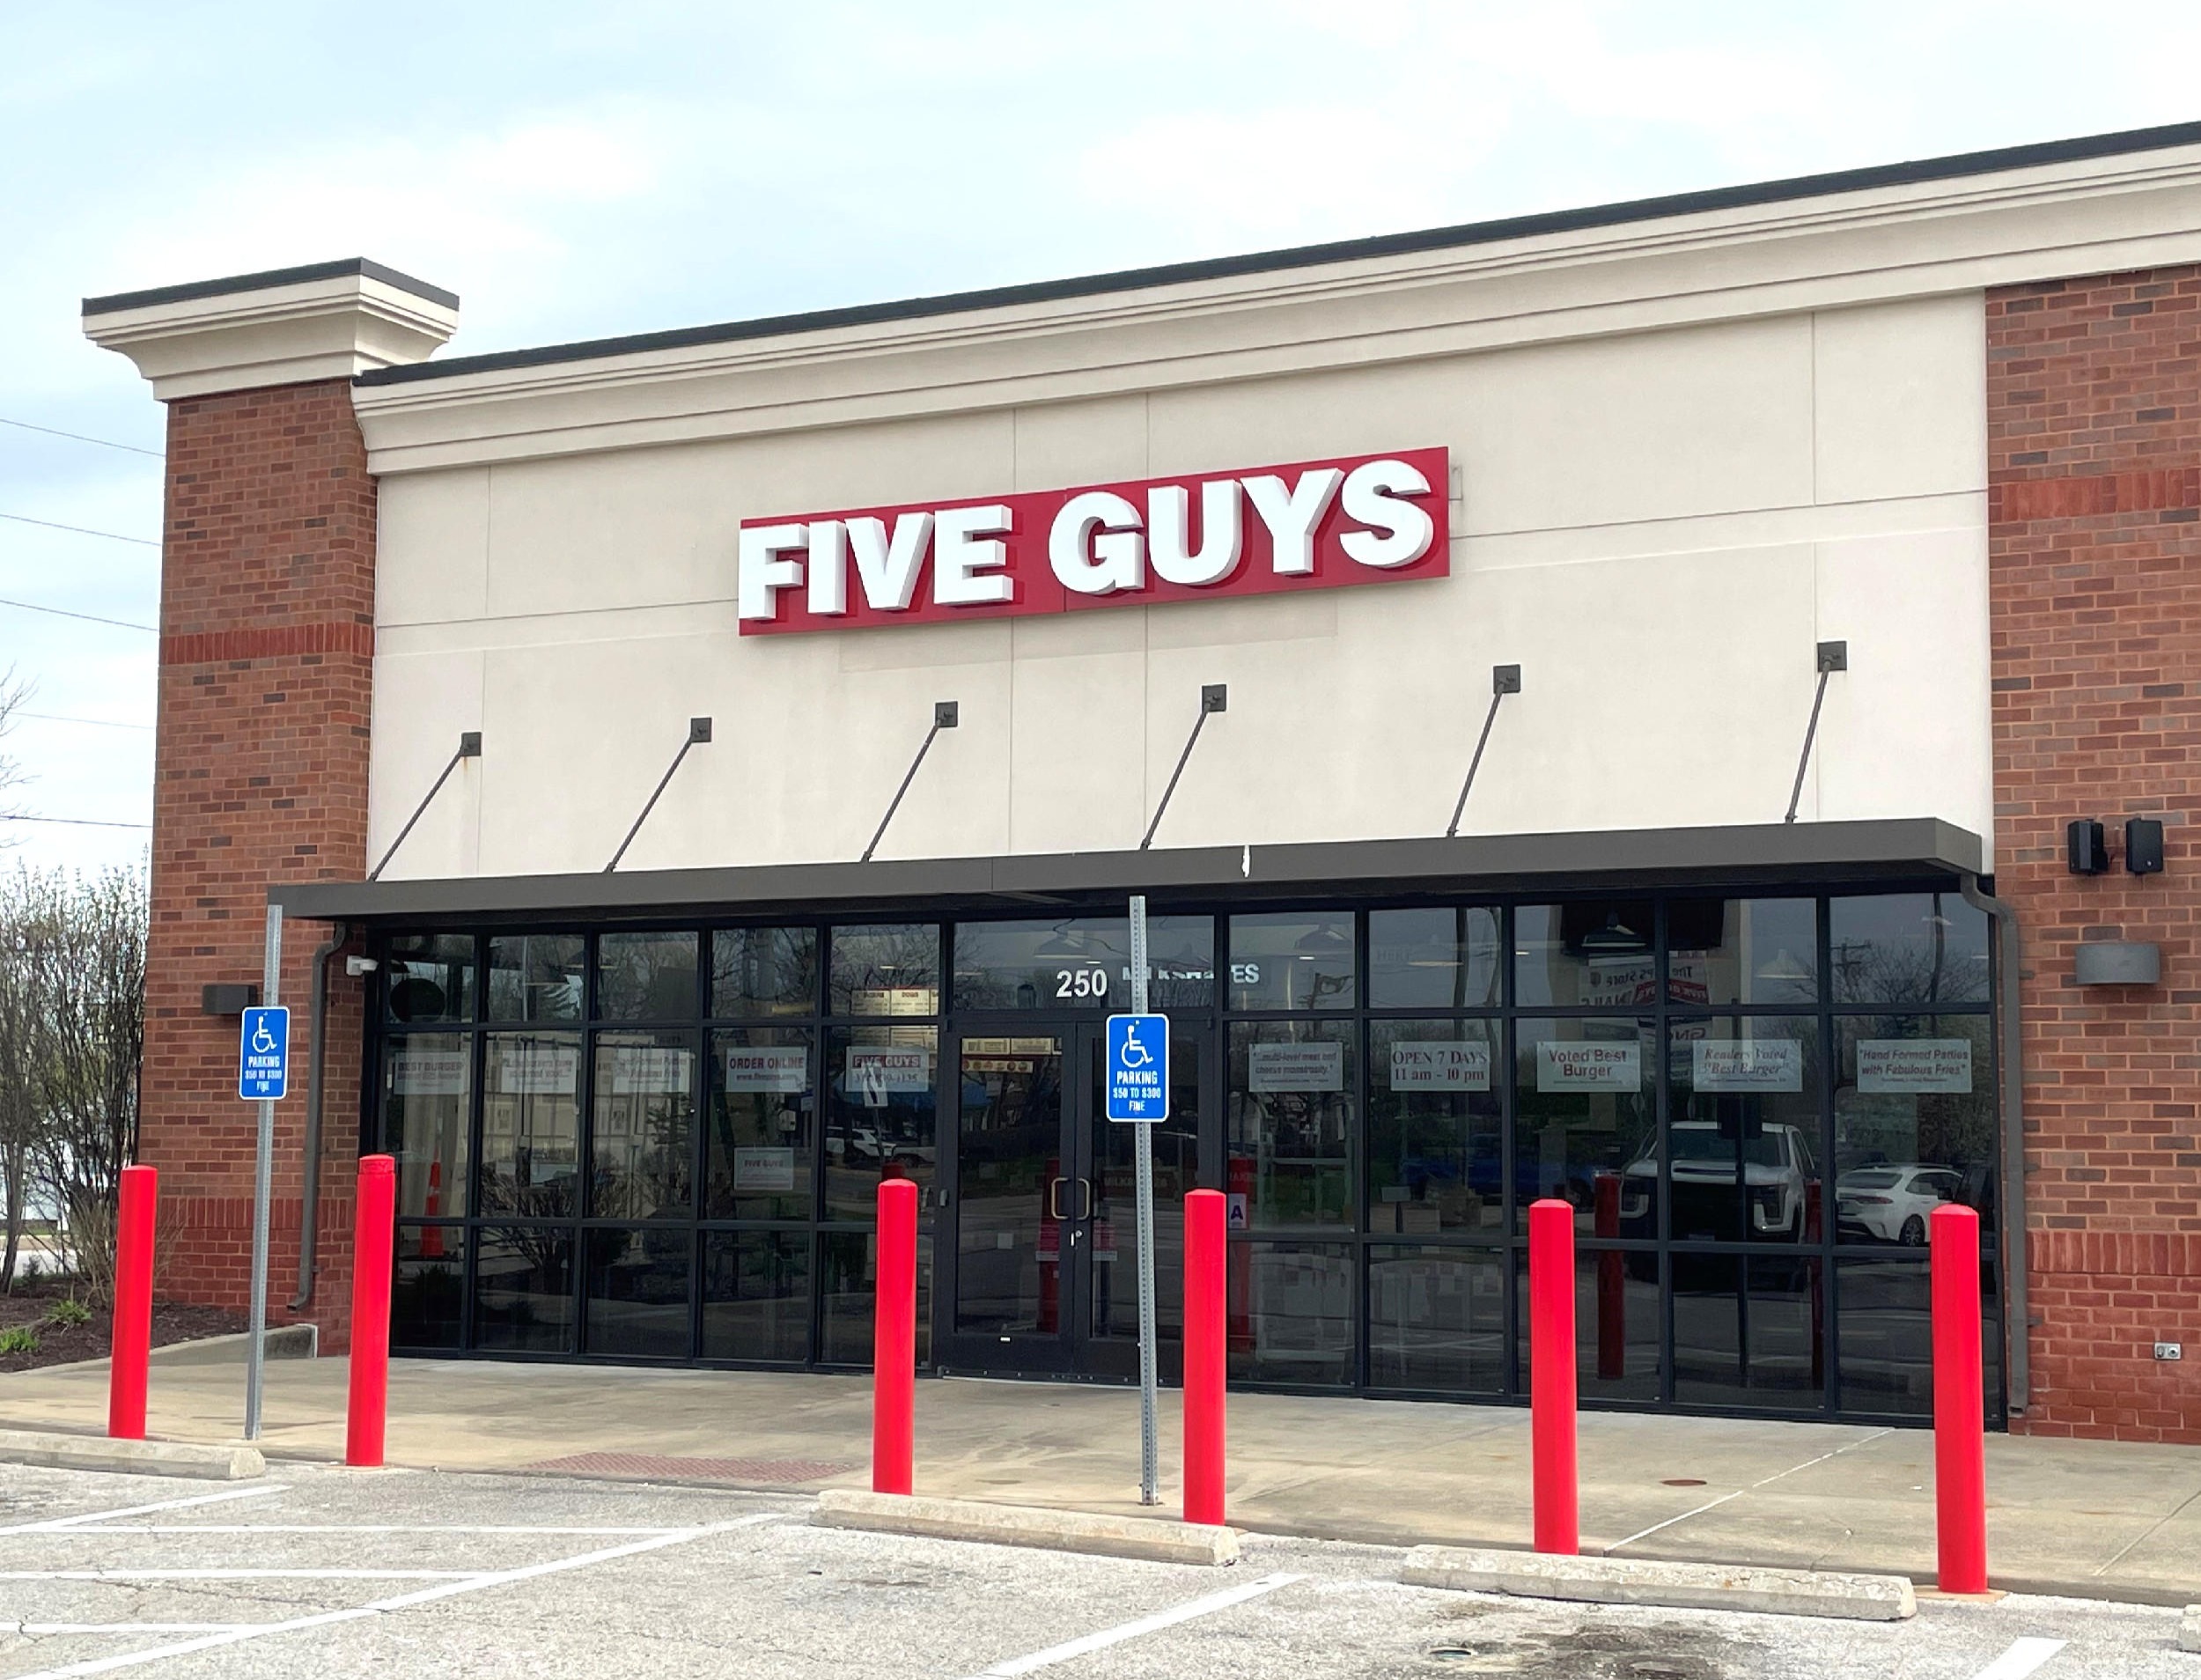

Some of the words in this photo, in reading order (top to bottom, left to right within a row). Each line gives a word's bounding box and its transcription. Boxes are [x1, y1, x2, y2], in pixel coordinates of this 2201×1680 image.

[738, 504, 1014, 622] FIVE
[1049, 459, 1433, 595] GUYS
[1056, 969, 1108, 997] 250
[1393, 1050, 1432, 1065] OPEN
[1437, 1050, 1445, 1065] 7
[1451, 1050, 1488, 1065] DAYS
[1549, 1049, 1589, 1062] Voted
[1594, 1049, 1627, 1062] Best
[1756, 1048, 1788, 1060] Voted
[1892, 1050, 1932, 1059] Formed
[1933, 1050, 1969, 1059] Patties
[248, 1057, 280, 1068] PARKING
[730, 1057, 764, 1069] ORDER
[768, 1057, 804, 1069] ONLINE
[854, 1056, 882, 1067] FIVE
[885, 1056, 920, 1067] GUYS
[1395, 1068, 1406, 1079] 11
[1412, 1071, 1432, 1079] am
[1446, 1068, 1460, 1080] 10
[1464, 1071, 1484, 1084] pm
[1563, 1064, 1612, 1079] Burger
[1862, 1065, 1882, 1075] with
[1886, 1065, 1932, 1074] Fabulous
[1116, 1071, 1158, 1085] PARKING
[1113, 1087, 1128, 1099] $50
[1130, 1087, 1139, 1099] TO
[1141, 1087, 1161, 1099] $300
[1129, 1101, 1145, 1111] FINE
[1230, 1205, 1244, 1220] A
